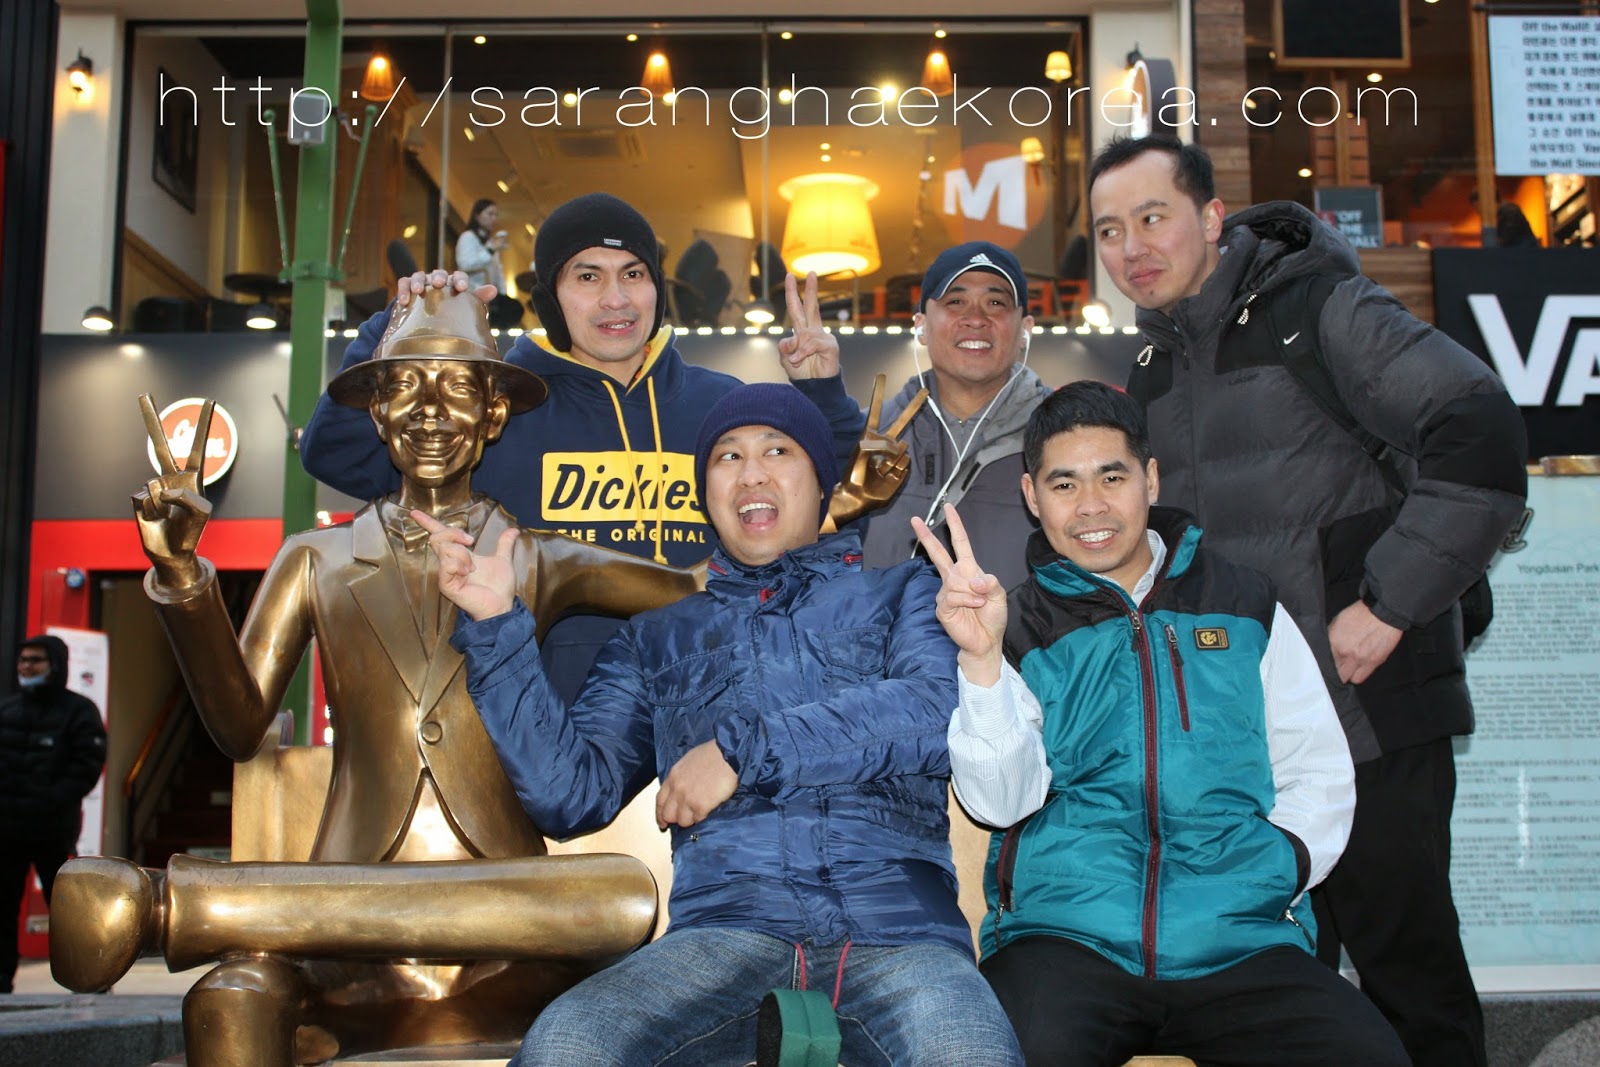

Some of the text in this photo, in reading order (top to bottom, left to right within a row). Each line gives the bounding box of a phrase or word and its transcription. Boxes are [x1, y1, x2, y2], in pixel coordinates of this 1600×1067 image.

[944, 154, 1027, 230] M
[547, 463, 700, 511] Dickie
[610, 528, 706, 544] ORIGINAL
